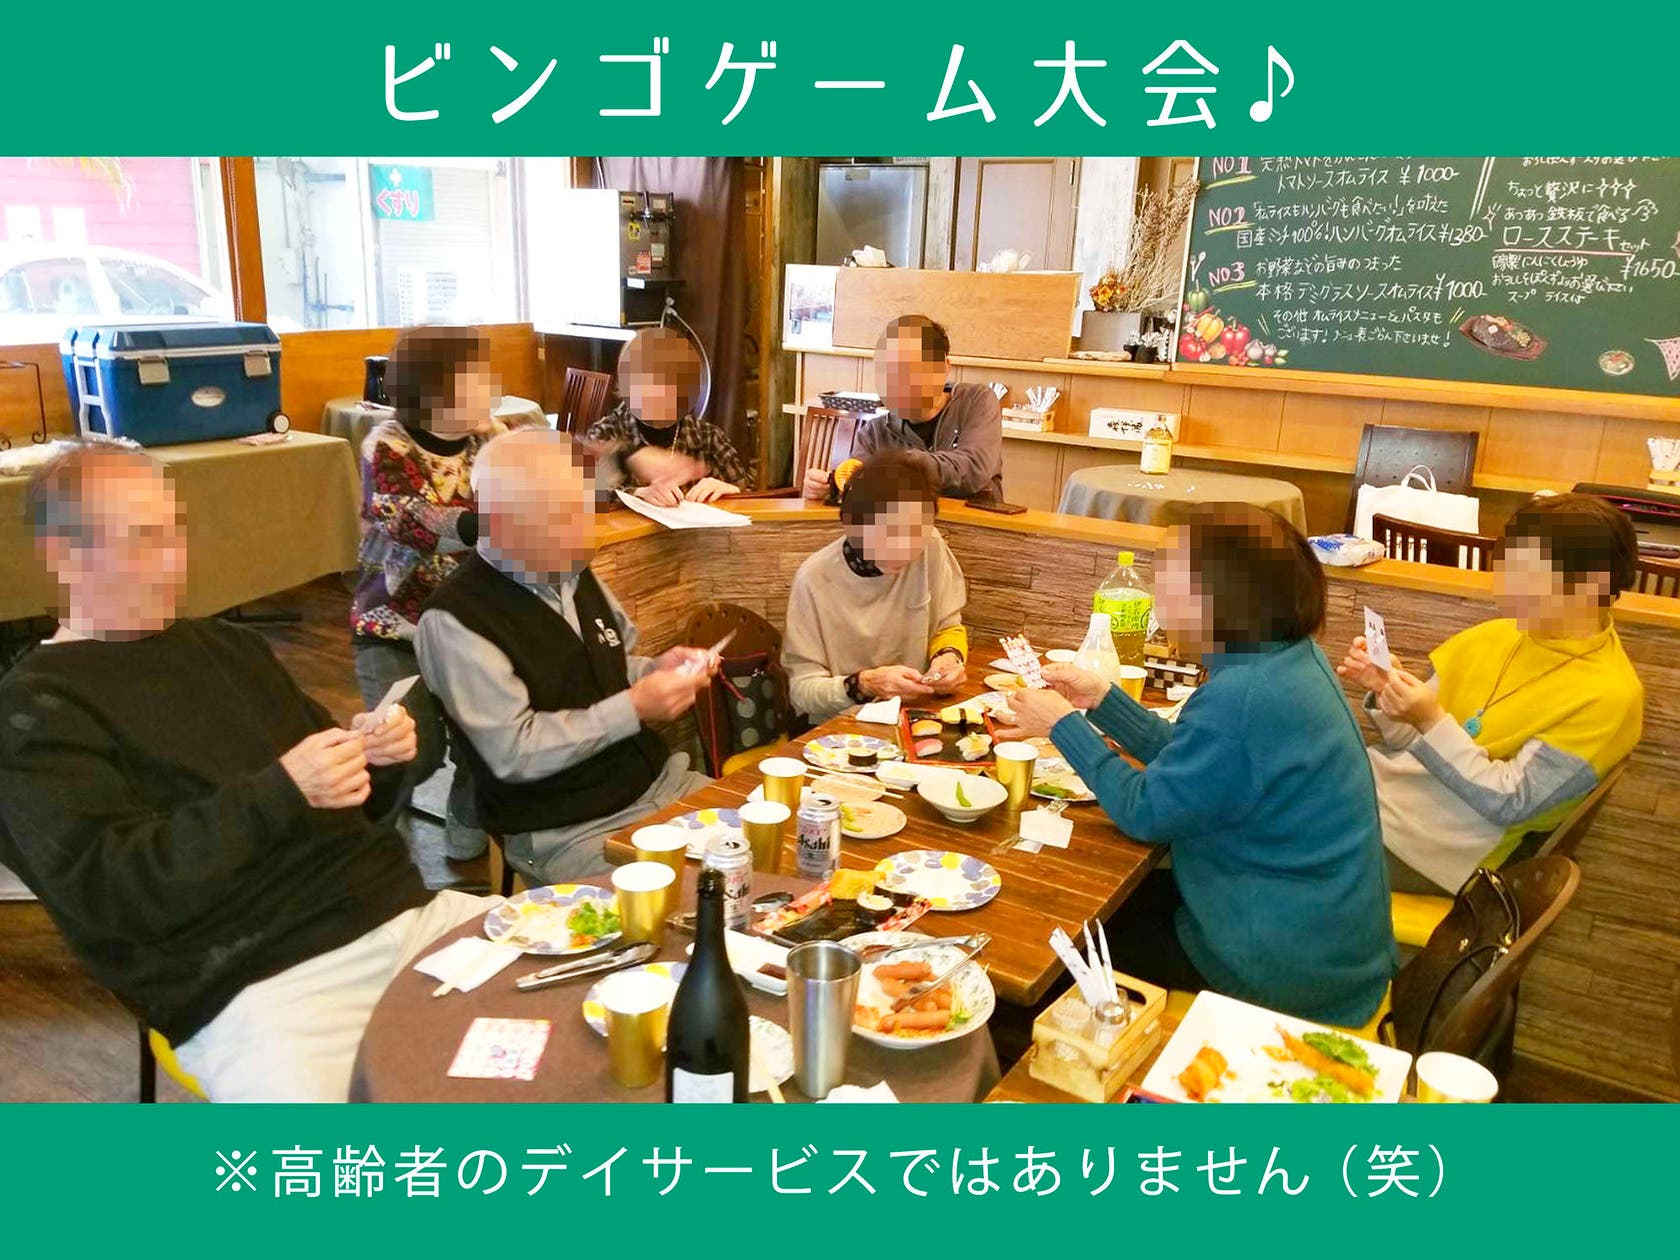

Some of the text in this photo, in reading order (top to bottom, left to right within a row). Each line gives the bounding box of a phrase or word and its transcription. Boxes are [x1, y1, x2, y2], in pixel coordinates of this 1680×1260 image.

[1277, 168, 1389, 194] トマトソースオムライス
[376, 188, 420, 218] くすり
[798, 834, 831, 850] Asahi
